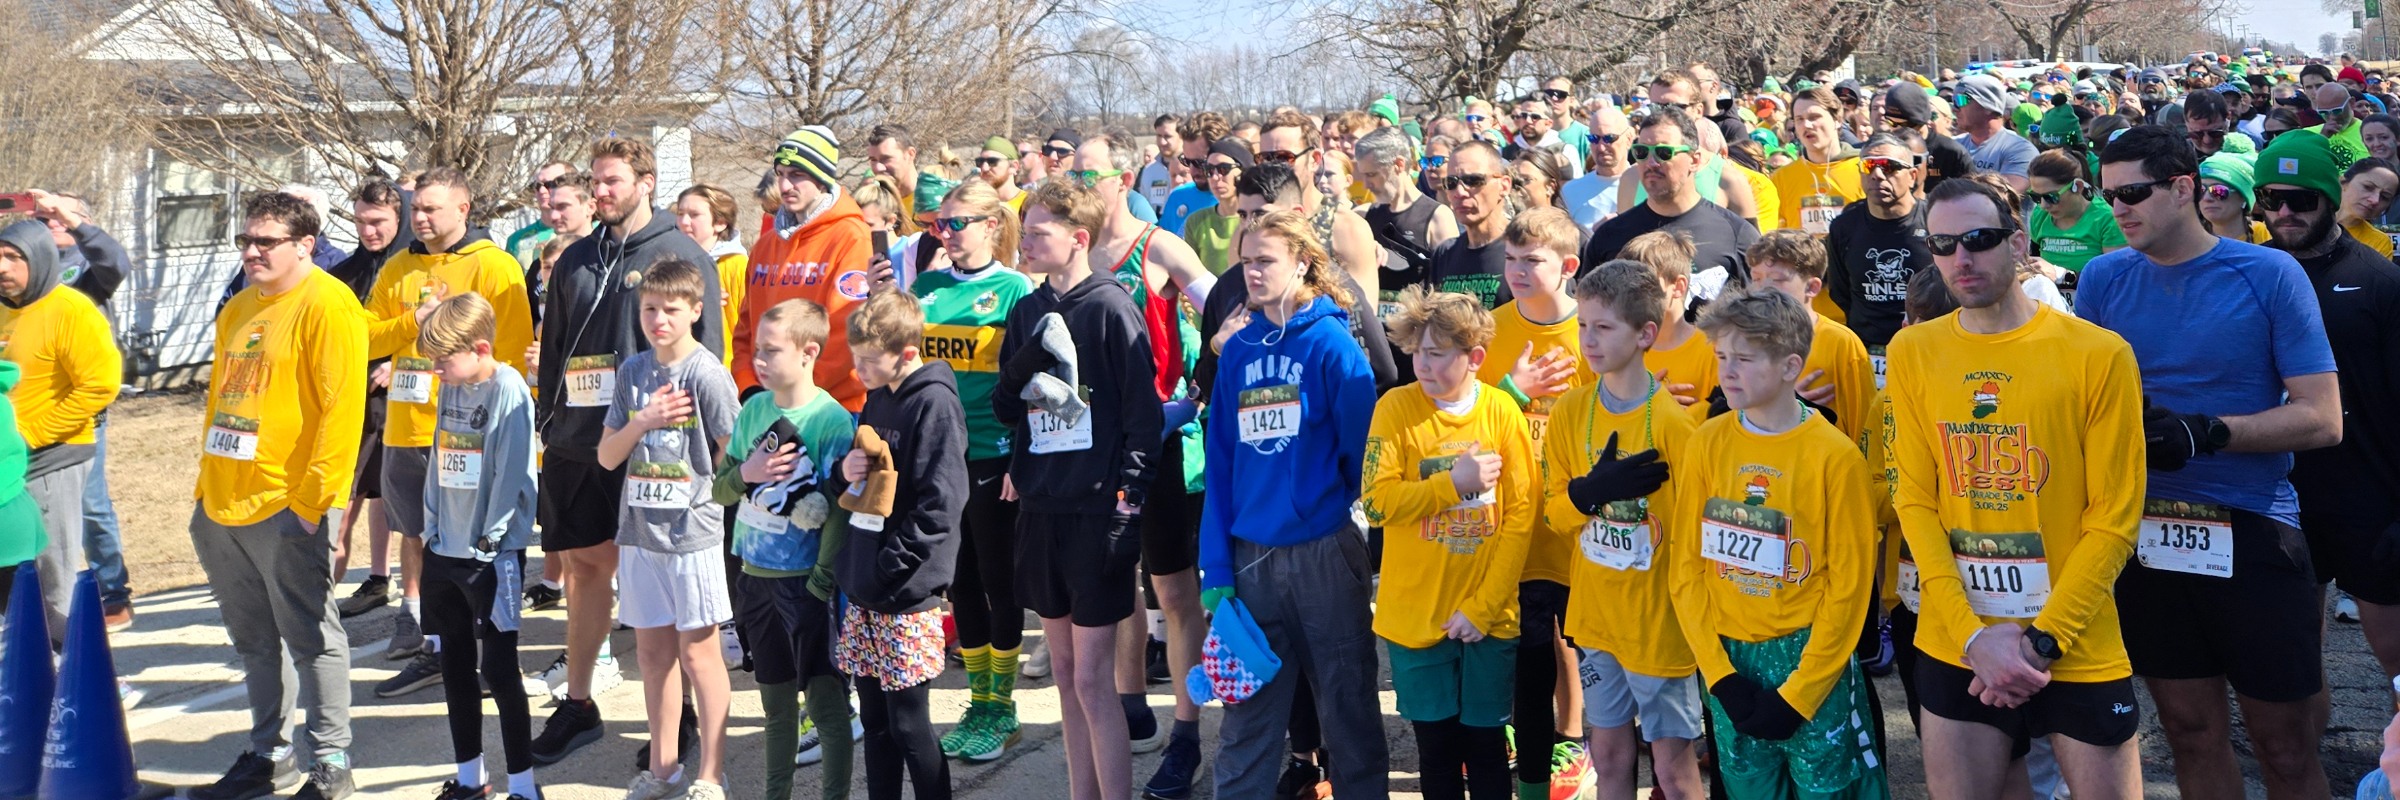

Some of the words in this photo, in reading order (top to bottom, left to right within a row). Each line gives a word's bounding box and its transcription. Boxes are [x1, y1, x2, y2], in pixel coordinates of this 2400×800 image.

[1442, 279, 1500, 294] SHAMROCK
[1862, 282, 1907, 295] TINLE
[396, 374, 417, 390] 1310
[576, 373, 601, 391] 1139
[1963, 371, 2013, 384] MCMXCV
[1041, 412, 1074, 433] 137
[1252, 408, 1287, 433] 1421
[211, 431, 241, 453] 1404
[441, 452, 467, 473] 1265
[635, 482, 674, 502] 1442
[1592, 520, 1632, 551] 1266
[1717, 529, 1763, 562] 1227
[2160, 523, 2211, 551] 1353
[1968, 563, 2023, 594] 1110
[2024, 604, 2046, 613] BEVERA
